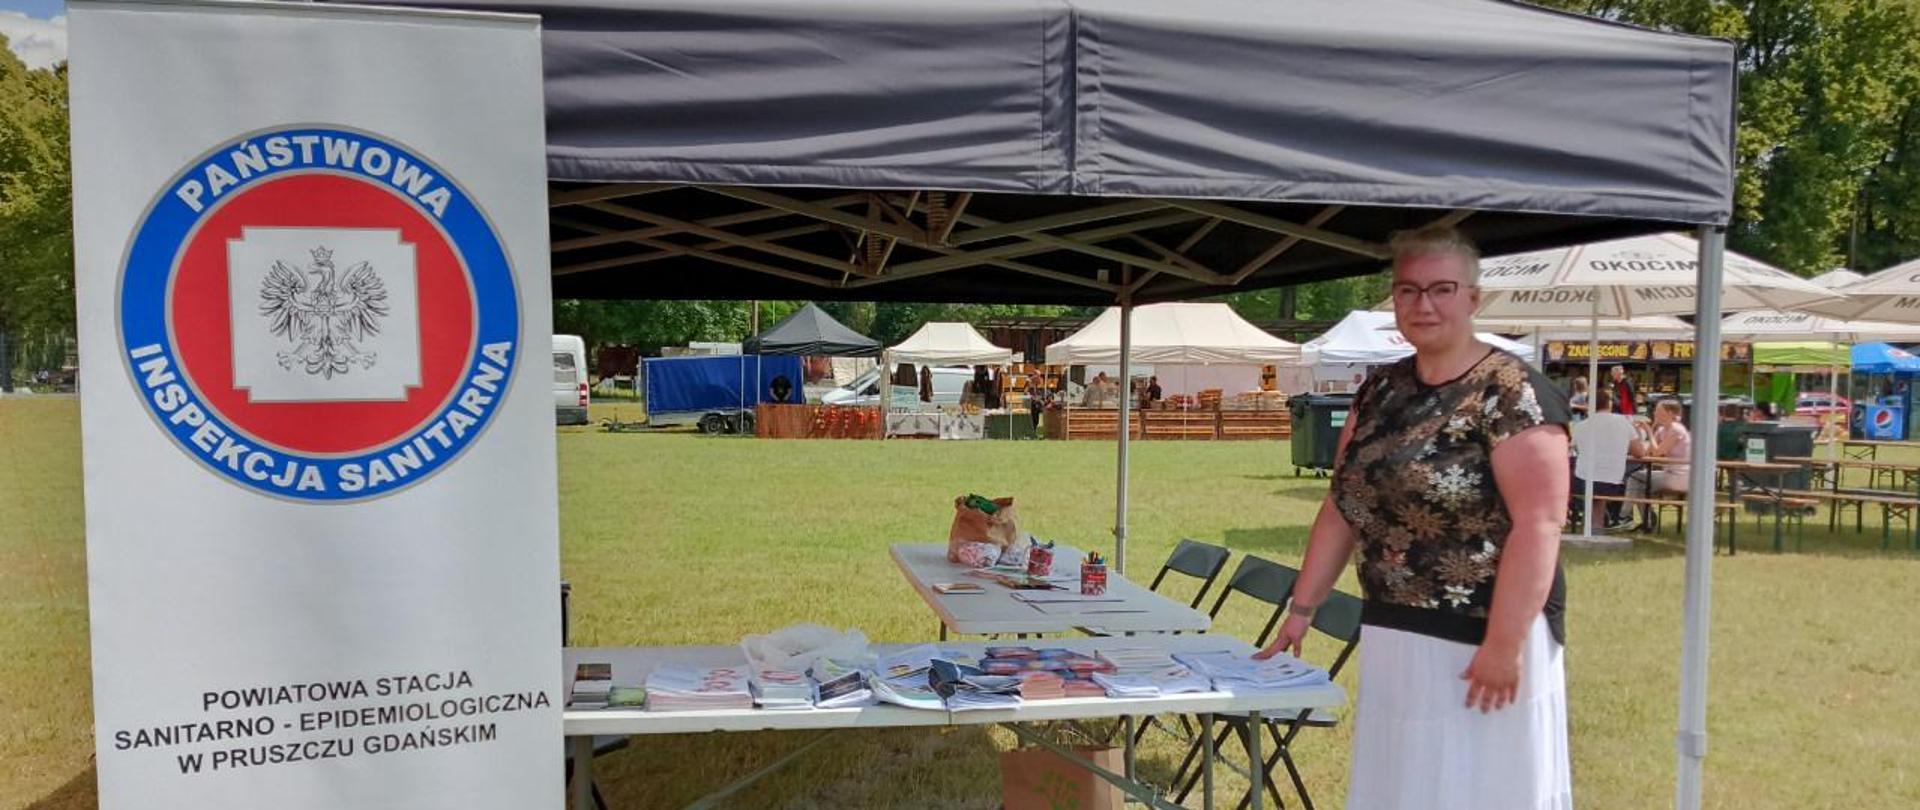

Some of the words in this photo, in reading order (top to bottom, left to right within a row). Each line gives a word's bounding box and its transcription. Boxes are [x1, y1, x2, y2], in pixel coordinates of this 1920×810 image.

[176, 136, 452, 218] PAŃSTWOWA
[1480, 263, 1550, 278] OCIM
[1590, 260, 1700, 271] OKOCIM
[129, 344, 325, 491] INSPEKCJA
[338, 342, 511, 490] SANITARNA
[202, 680, 368, 711] POWIATOWA
[376, 671, 473, 696] STACJA
[115, 717, 275, 750] SANITARNO
[299, 691, 550, 733] EPIDEMIOLOGICZNA
[177, 754, 203, 774] W
[212, 738, 354, 770] PRUSZCZU
[363, 723, 498, 755] GDAŃSKIM
